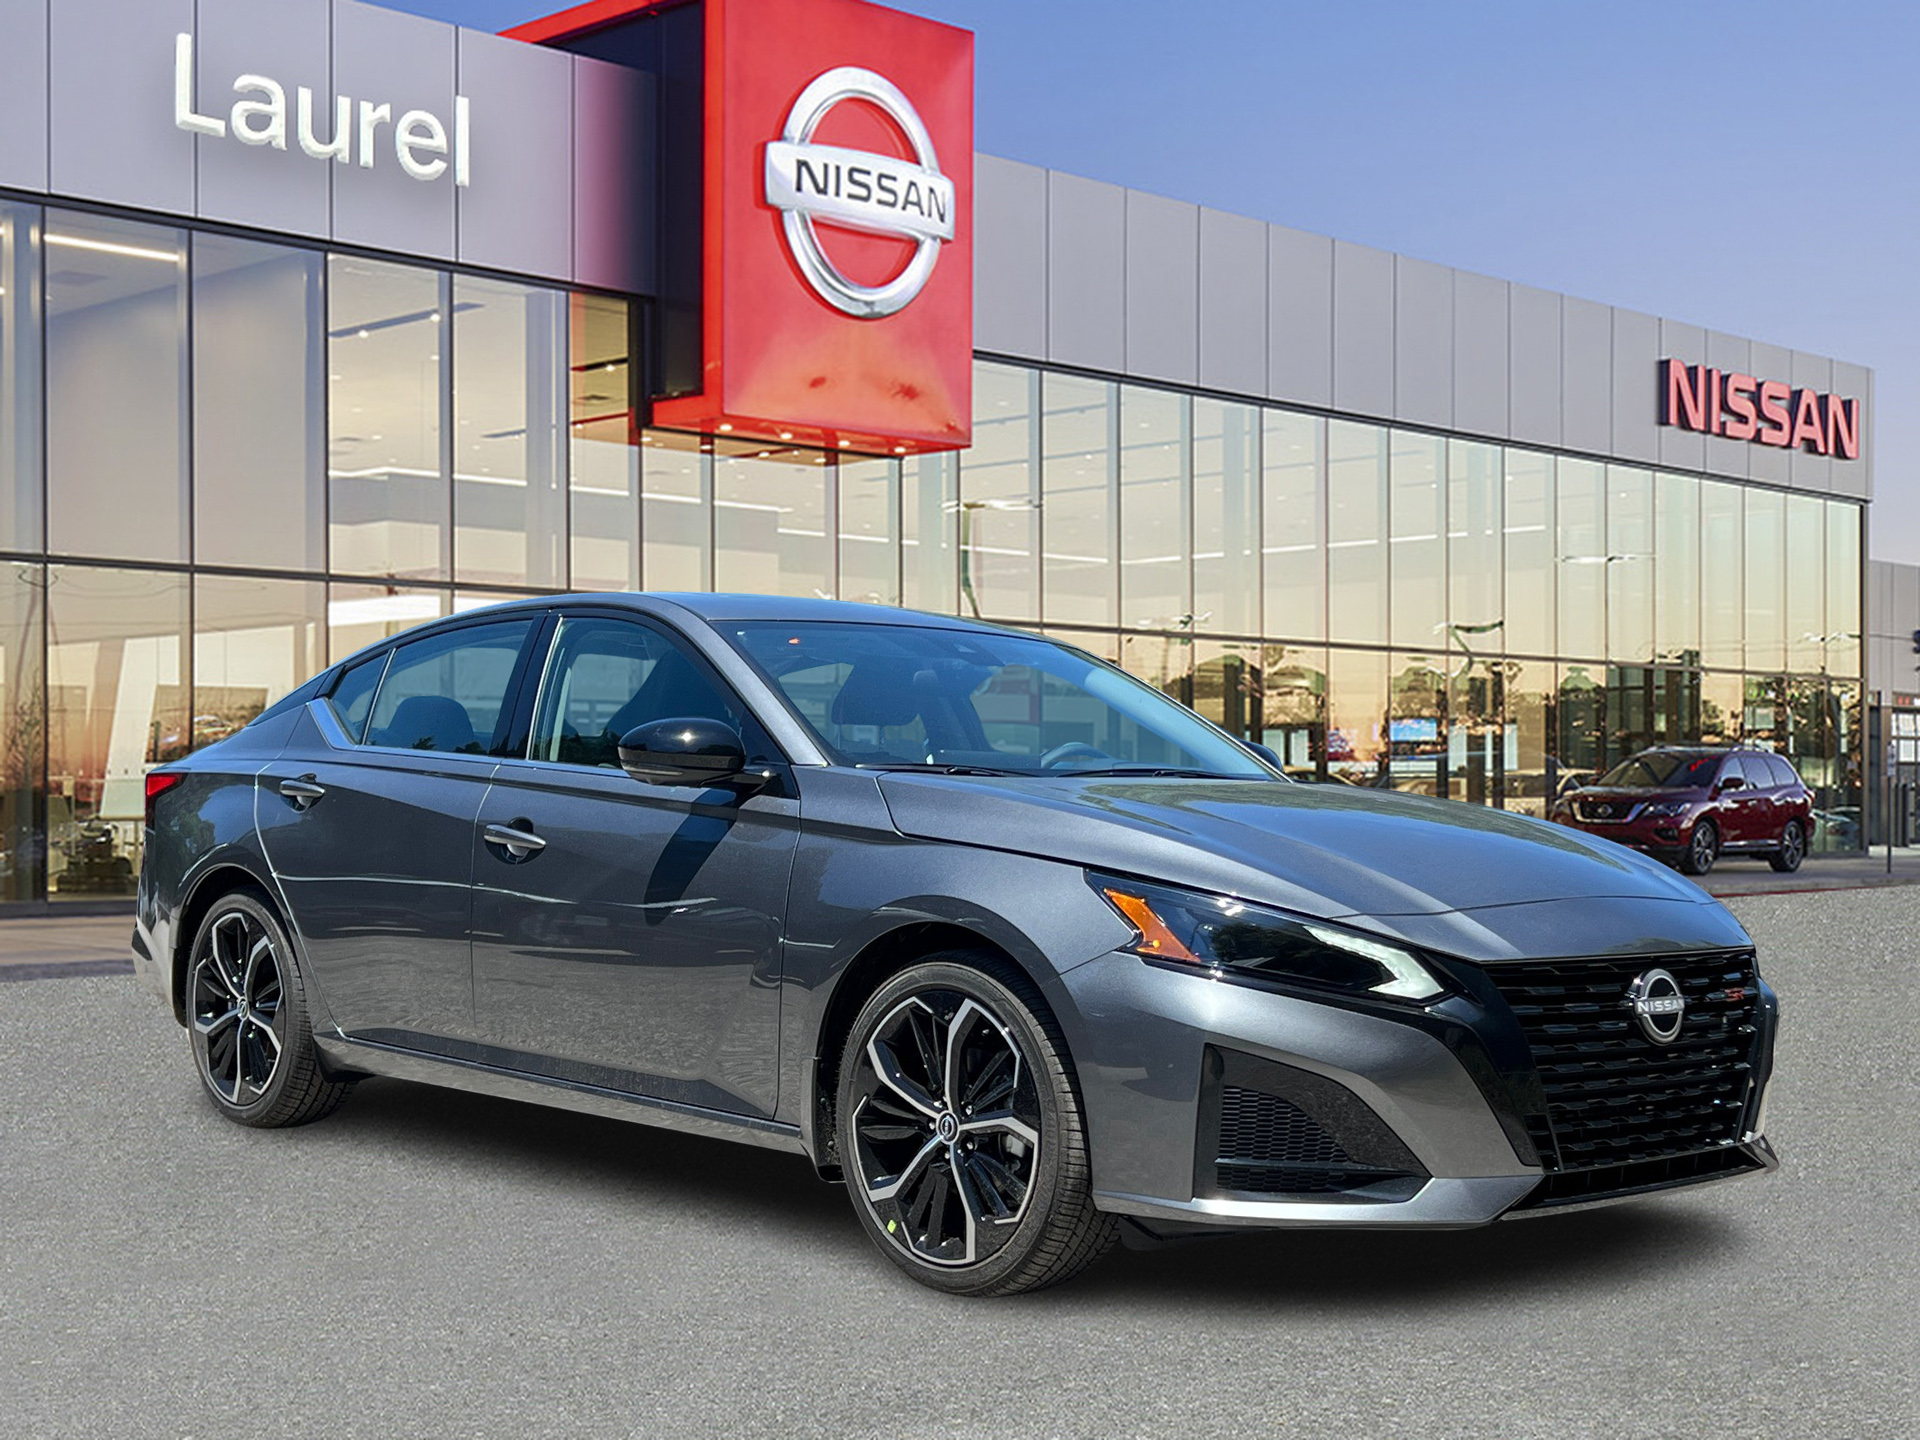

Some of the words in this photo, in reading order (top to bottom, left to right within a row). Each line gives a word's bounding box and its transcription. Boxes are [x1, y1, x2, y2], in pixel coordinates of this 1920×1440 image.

[175, 32, 469, 187] Laurel
[795, 158, 946, 223] NISSAN
[1657, 358, 1860, 460] NISSAN
[1636, 999, 1684, 1013] NISSAN
